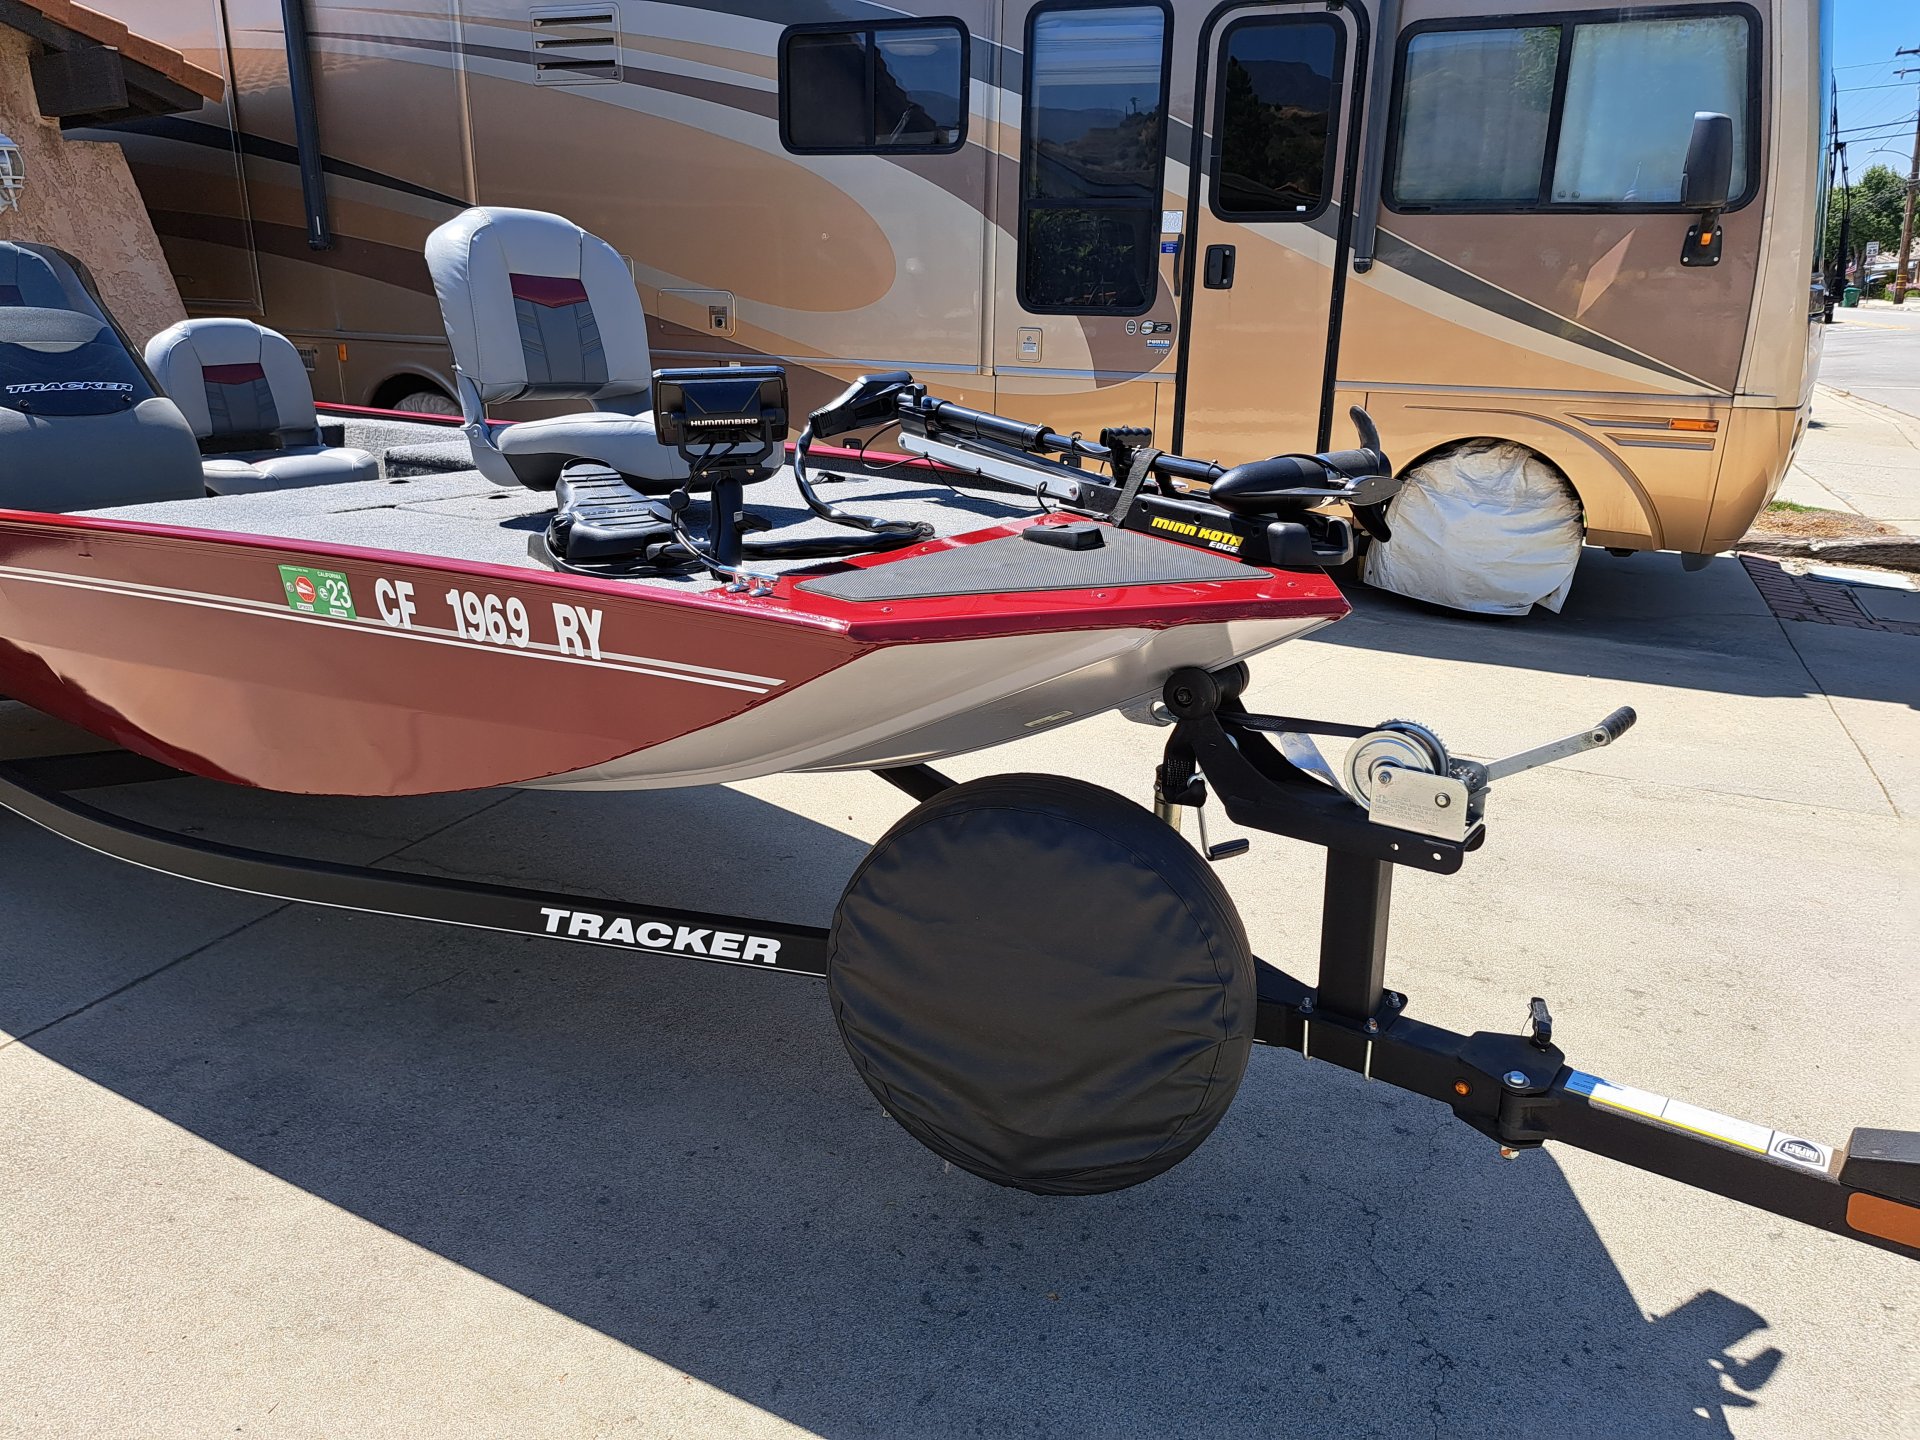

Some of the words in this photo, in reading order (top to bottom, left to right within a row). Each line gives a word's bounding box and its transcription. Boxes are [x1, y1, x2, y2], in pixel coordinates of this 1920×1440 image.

[5, 381, 134, 394] TRACKER
[690, 418, 759, 427] HUMMINBIRD
[1151, 517, 1198, 537] MINN
[1197, 527, 1244, 547] KOTA
[1208, 541, 1240, 553] EDGE
[316, 571, 343, 580] CALIFORNIA
[325, 579, 352, 608] 23
[374, 577, 417, 630] CF
[445, 588, 530, 648] 1969
[551, 602, 603, 661] RY
[540, 907, 781, 964] TRACKER
[1783, 1142, 1819, 1161] IMPACT
